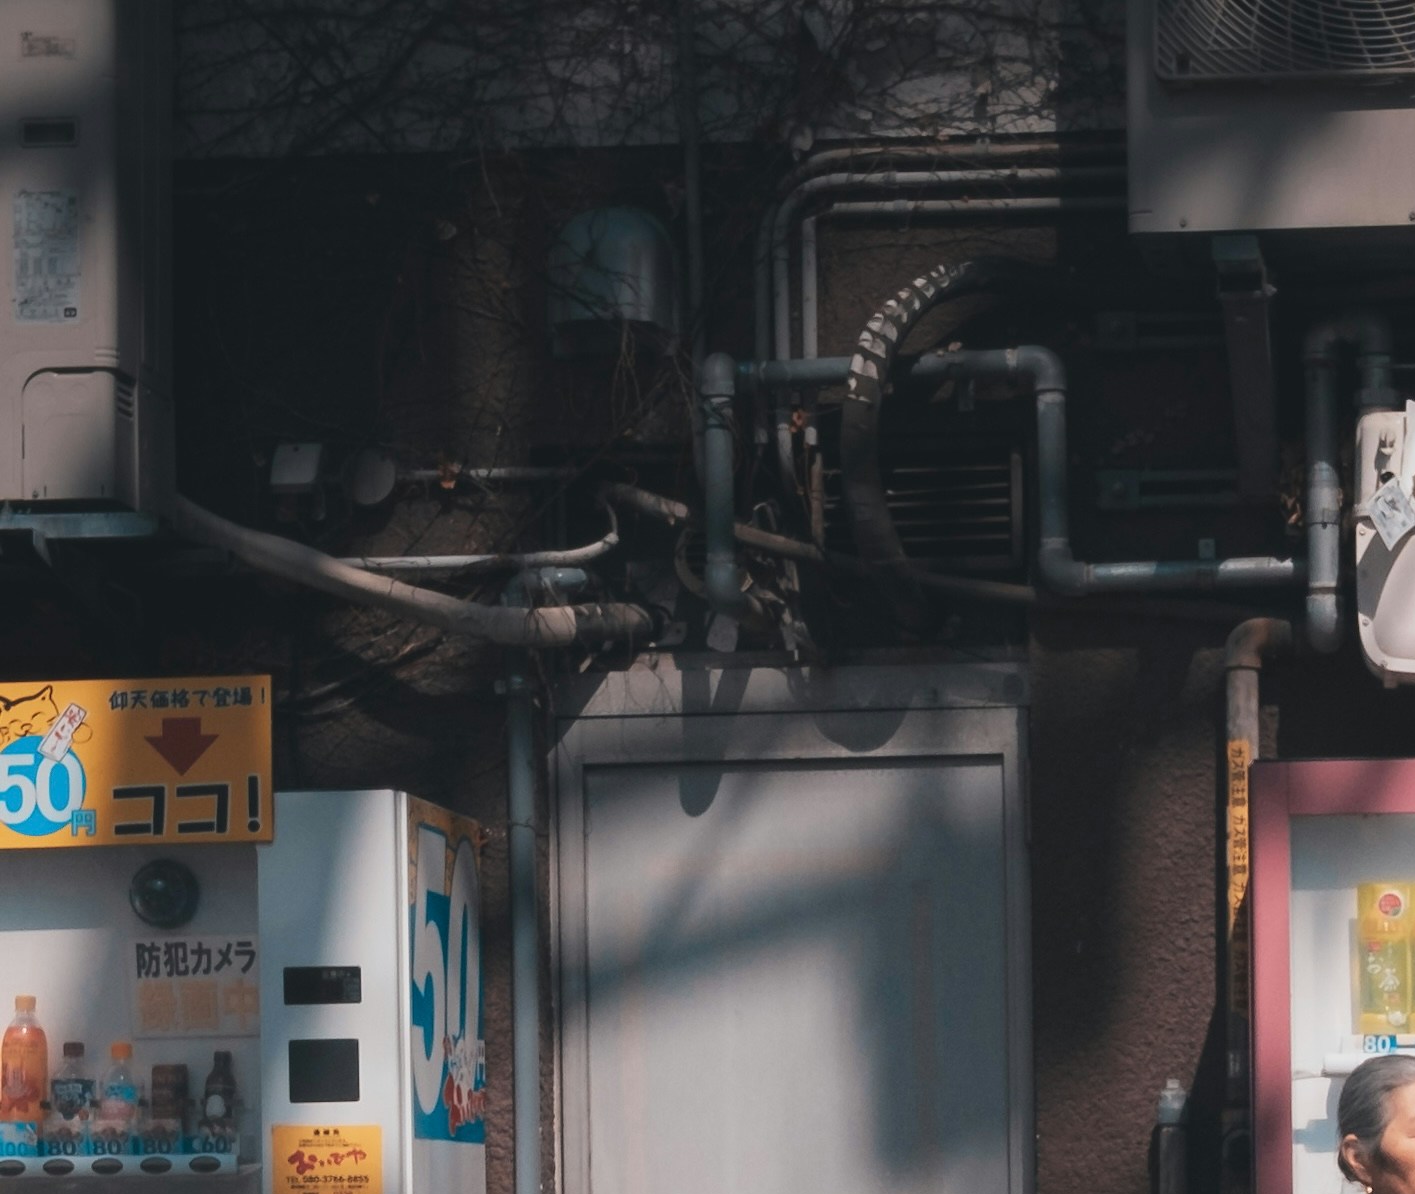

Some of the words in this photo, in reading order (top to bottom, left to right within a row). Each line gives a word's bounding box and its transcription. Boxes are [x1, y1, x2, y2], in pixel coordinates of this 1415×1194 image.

[135, 941, 257, 979] 防犯カメラ
[1364, 1035, 1390, 1052] 80
